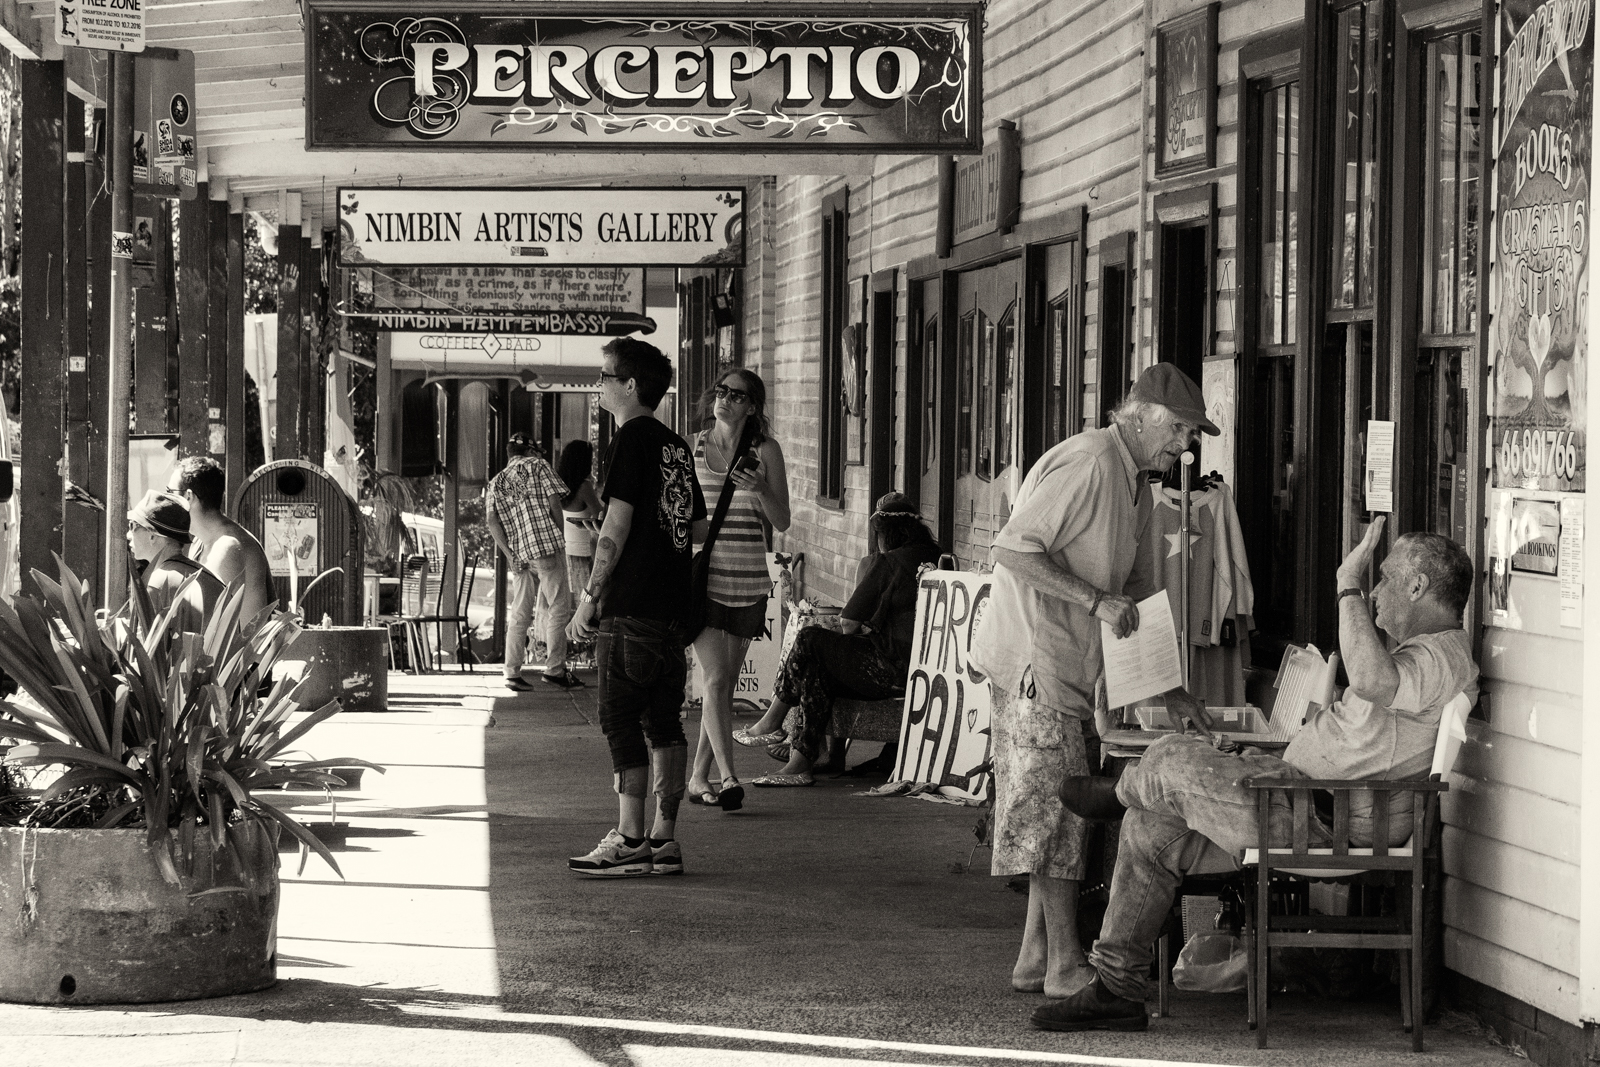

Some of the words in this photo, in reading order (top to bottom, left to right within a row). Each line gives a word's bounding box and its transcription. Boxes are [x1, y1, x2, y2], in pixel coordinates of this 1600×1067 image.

[110, 0, 141, 11] ZONE
[114, 20, 121, 28] TO
[411, 42, 922, 101] PERCEPTIO
[1514, 122, 1572, 198] BOOKS
[365, 212, 461, 243] NIMBIN
[474, 212, 583, 243] ARTISTS
[597, 212, 718, 243] GALLERY
[1501, 199, 1585, 256] CRYSTALS
[457, 267, 467, 277] is
[472, 268, 480, 277] a
[484, 267, 507, 277] law
[540, 267, 574, 279] seeks
[575, 267, 586, 280] to
[445, 278, 461, 288] as
[465, 278, 473, 288] a
[523, 280, 537, 290] as
[558, 279, 591, 291] there
[467, 288, 524, 302] feloniously
[530, 292, 565, 303] wrong
[568, 290, 590, 302] with
[379, 310, 450, 329] NIMBIN
[462, 311, 513, 331] HEMP
[521, 313, 611, 334] EMBASSY
[426, 336, 478, 350] COFFEE
[506, 337, 533, 350] BAR
[1527, 541, 1557, 558] BOOKINGS
[735, 677, 759, 692] ISTS
[898, 668, 992, 796] PAL
